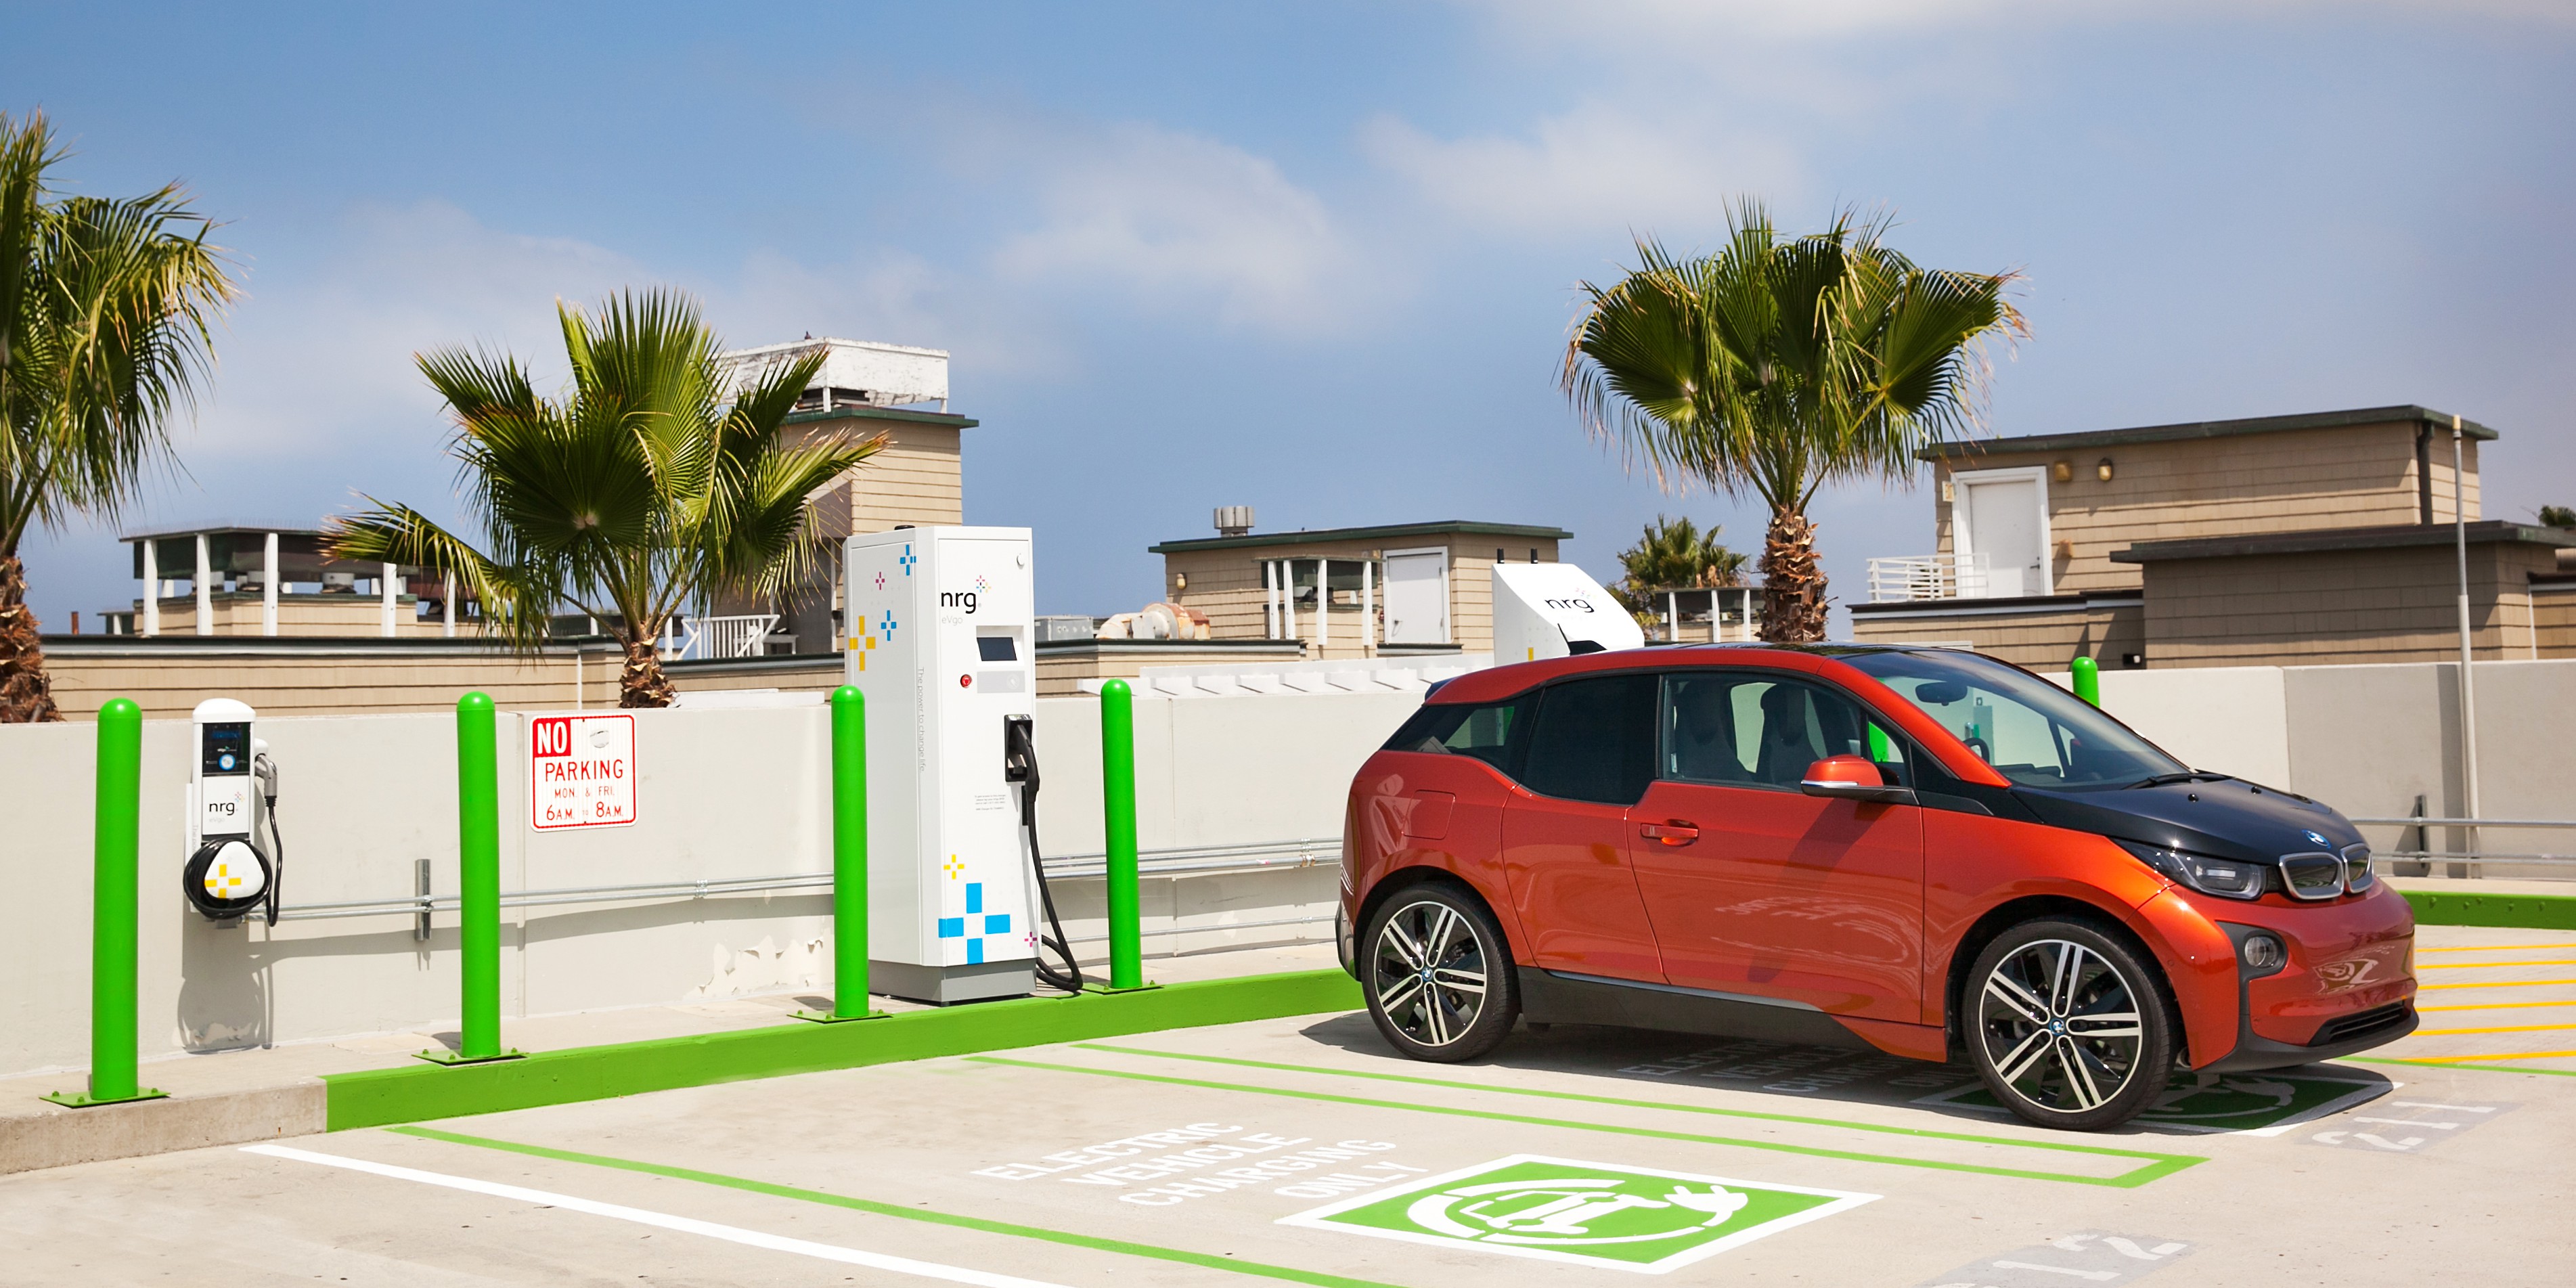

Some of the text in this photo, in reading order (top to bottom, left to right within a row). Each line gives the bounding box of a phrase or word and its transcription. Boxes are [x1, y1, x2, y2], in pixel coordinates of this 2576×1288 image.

[941, 592, 977, 614] nrg
[1544, 599, 1595, 613] nrg
[918, 714, 925, 724] to
[537, 721, 567, 754] NO
[546, 759, 623, 782] PARKING
[585, 787, 590, 797] &
[209, 803, 235, 816] nrg
[2311, 1101, 2497, 1150] 211
[969, 1122, 1244, 1181] ELECTRIC
[1060, 1132, 1312, 1186] VEHICLE
[1118, 1139, 1396, 1206] CHARGING
[1274, 1161, 1429, 1199] ONLY
[1931, 1234, 2188, 1288] 12
